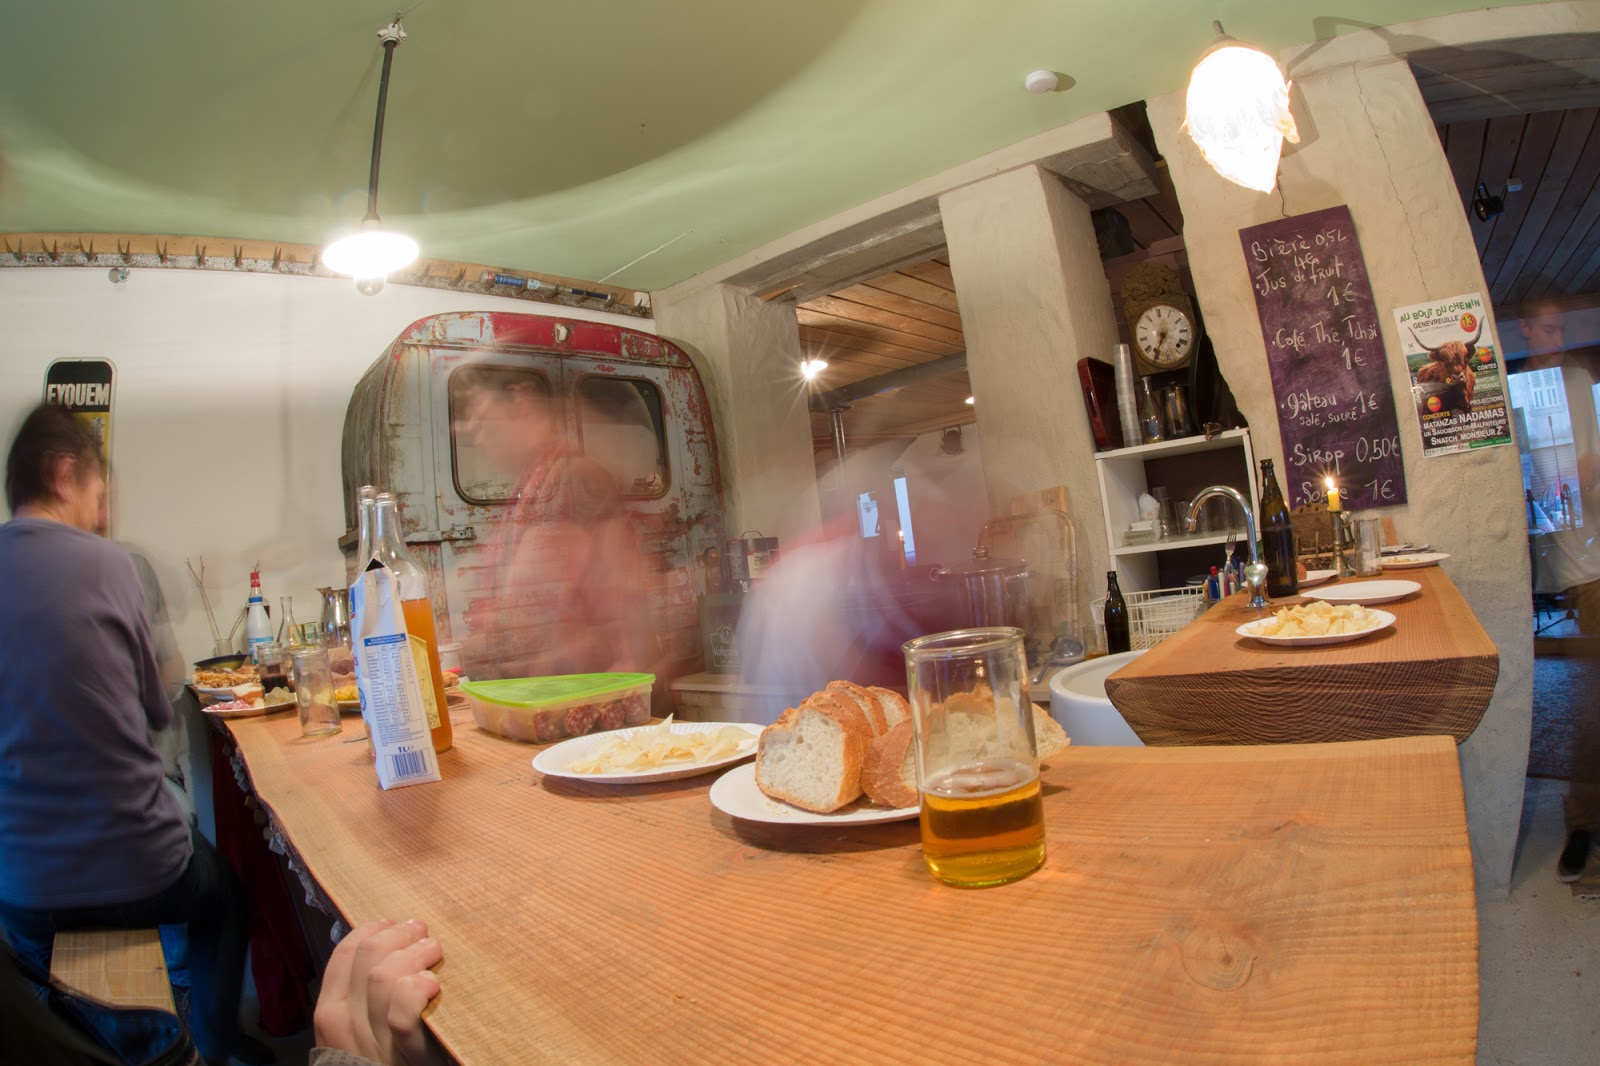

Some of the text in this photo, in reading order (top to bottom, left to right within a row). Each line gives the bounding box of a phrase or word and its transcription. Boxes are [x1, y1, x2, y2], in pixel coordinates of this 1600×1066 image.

[1256, 267, 1287, 296] Jus
[1400, 298, 1482, 324] AU BOUT DU CHEMIN
[1412, 314, 1460, 330] GENEVREUILLE
[1462, 315, 1475, 327] 13
[1342, 347, 1368, 370] 1€
[1477, 362, 1497, 371] CONTES
[1354, 391, 1380, 413] 1€
[1470, 395, 1505, 406] PROJECTIONS
[1422, 410, 1451, 421] CONCERTS
[1458, 407, 1505, 424] NADAMAS
[1460, 428, 1496, 441] MONSIEUR
[1496, 425, 1504, 436] Z
